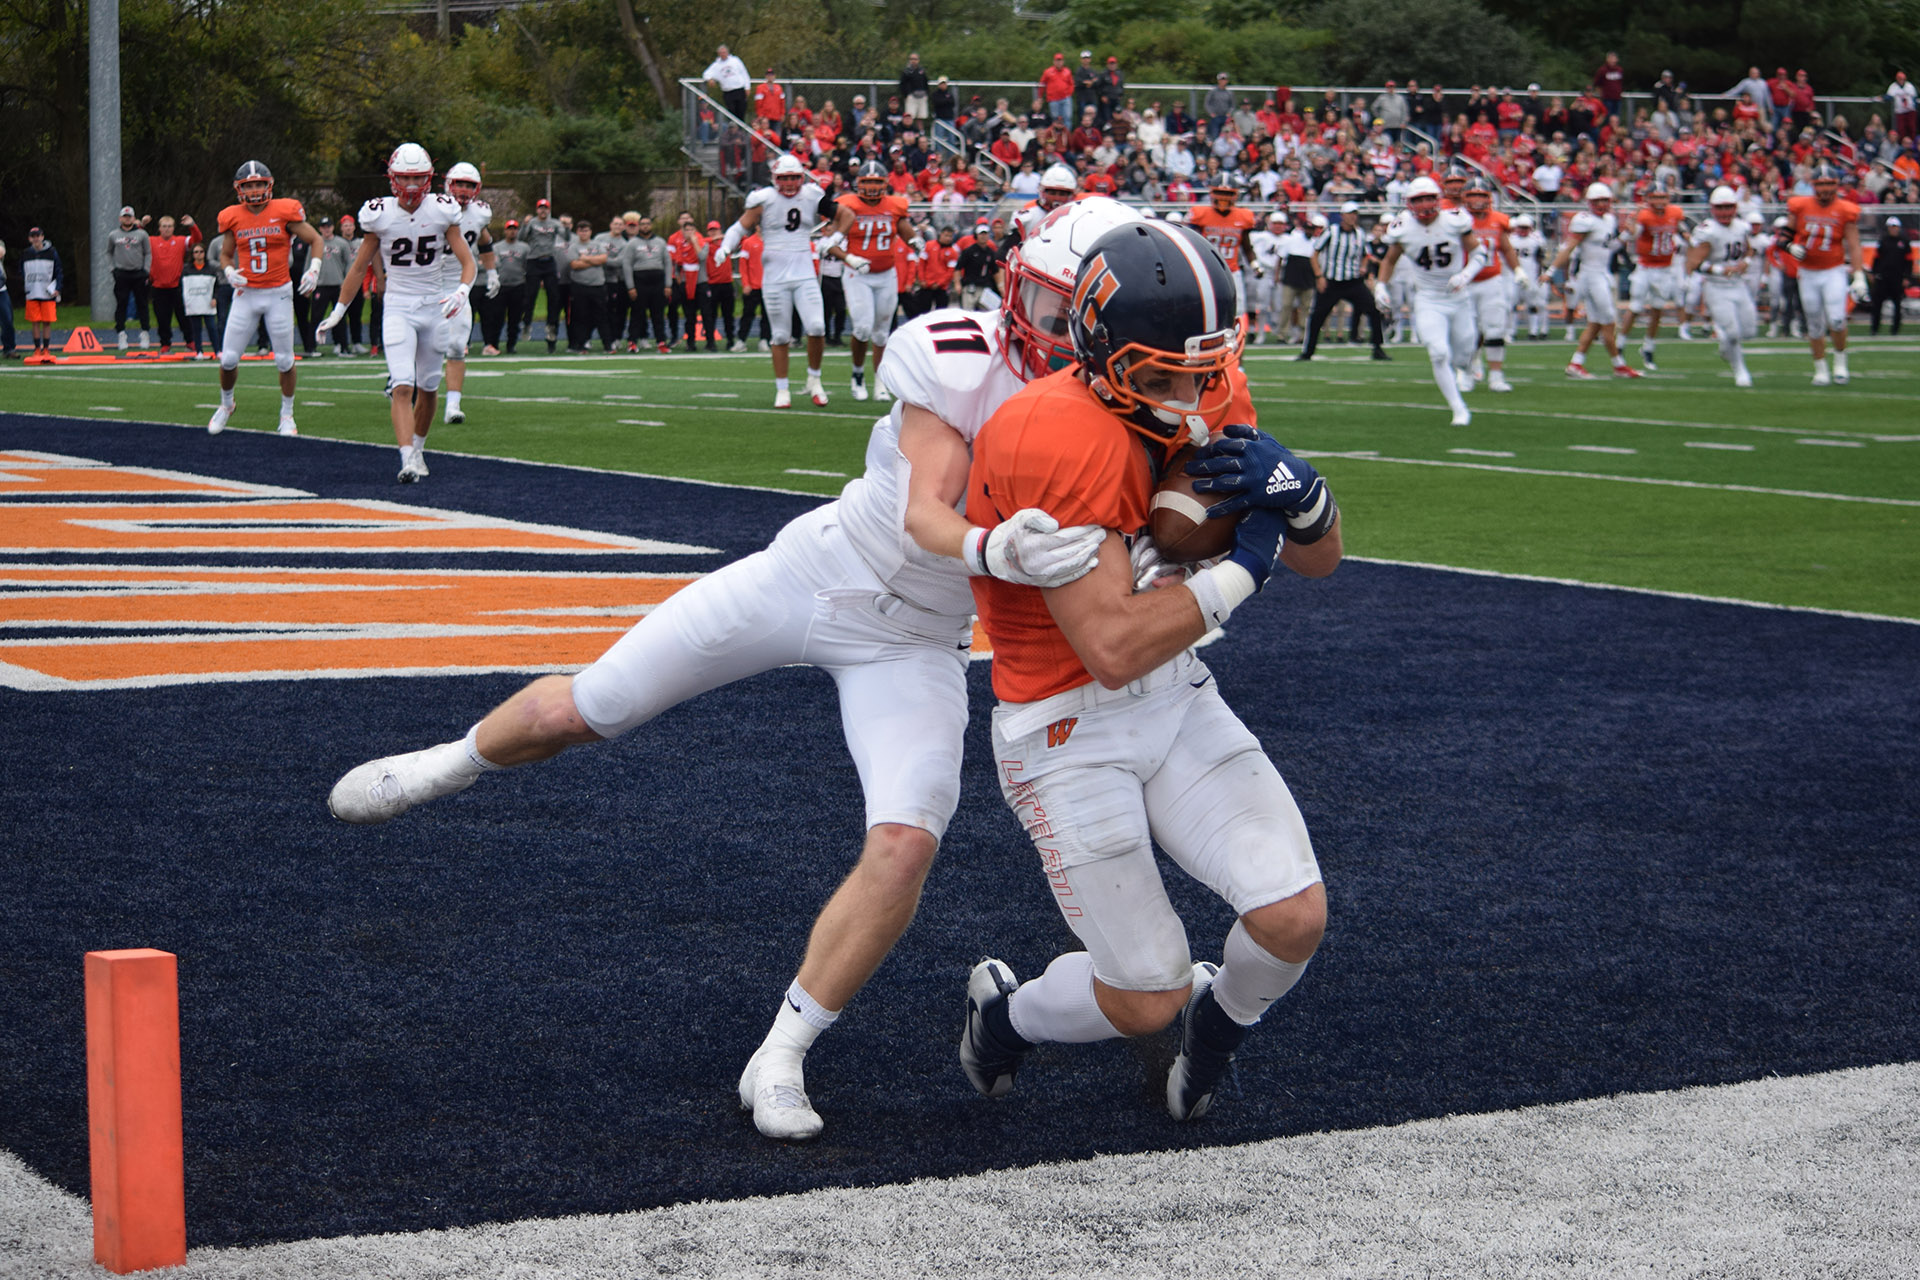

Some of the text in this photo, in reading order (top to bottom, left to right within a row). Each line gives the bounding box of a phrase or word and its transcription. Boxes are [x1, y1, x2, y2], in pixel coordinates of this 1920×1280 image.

[237, 226, 281, 238] WHEATON
[785, 208, 801, 232] 9
[390, 234, 437, 266] 25
[857, 220, 892, 251] 72
[1805, 222, 1833, 252] 71
[249, 238, 267, 274] 5
[1416, 241, 1452, 271] 45
[78, 331, 95, 349] 10
[926, 317, 991, 355] 11
[1266, 480, 1301, 495] adidas
[1047, 717, 1079, 748] W
